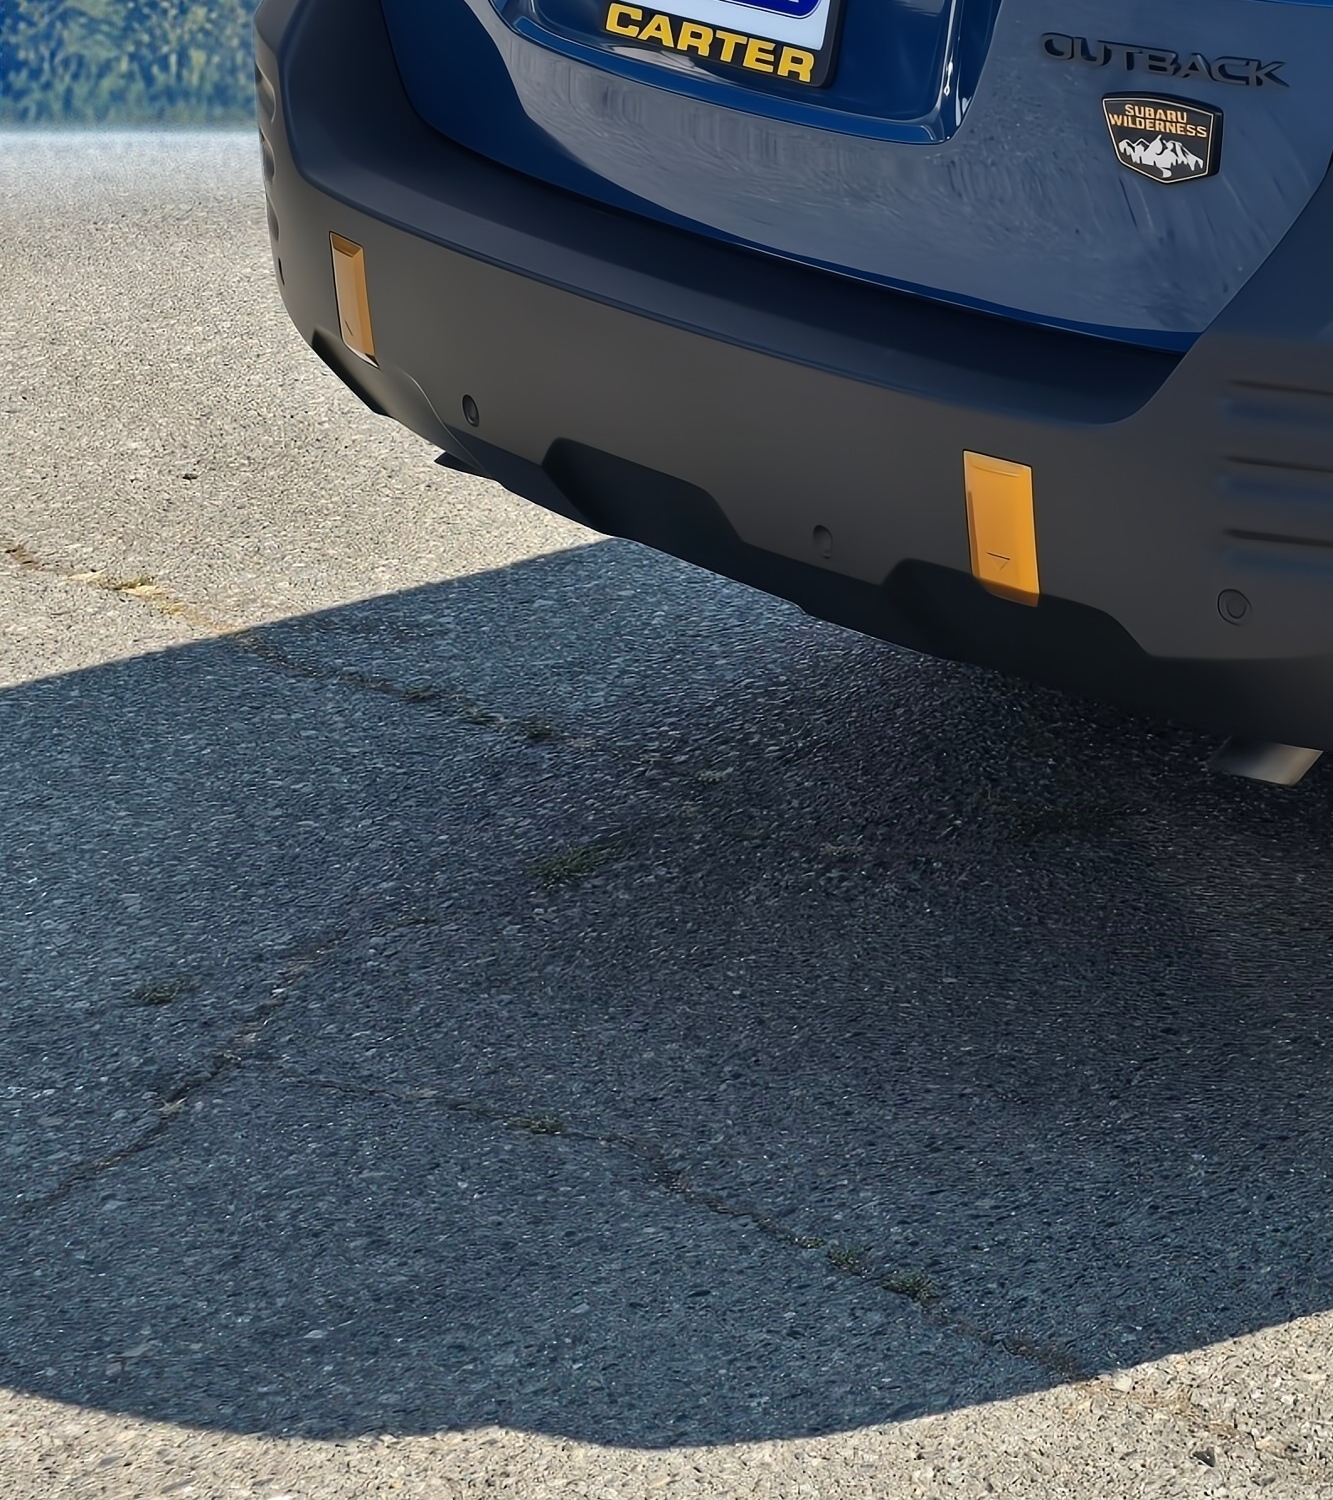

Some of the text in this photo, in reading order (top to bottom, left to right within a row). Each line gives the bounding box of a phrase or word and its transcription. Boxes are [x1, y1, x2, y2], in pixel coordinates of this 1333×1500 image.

[605, 2, 815, 82] CARTER
[1040, 32, 1290, 88] OUTBACK
[1108, 113, 1208, 138] WILDERNESS
[1124, 104, 1188, 124] SUBARU
